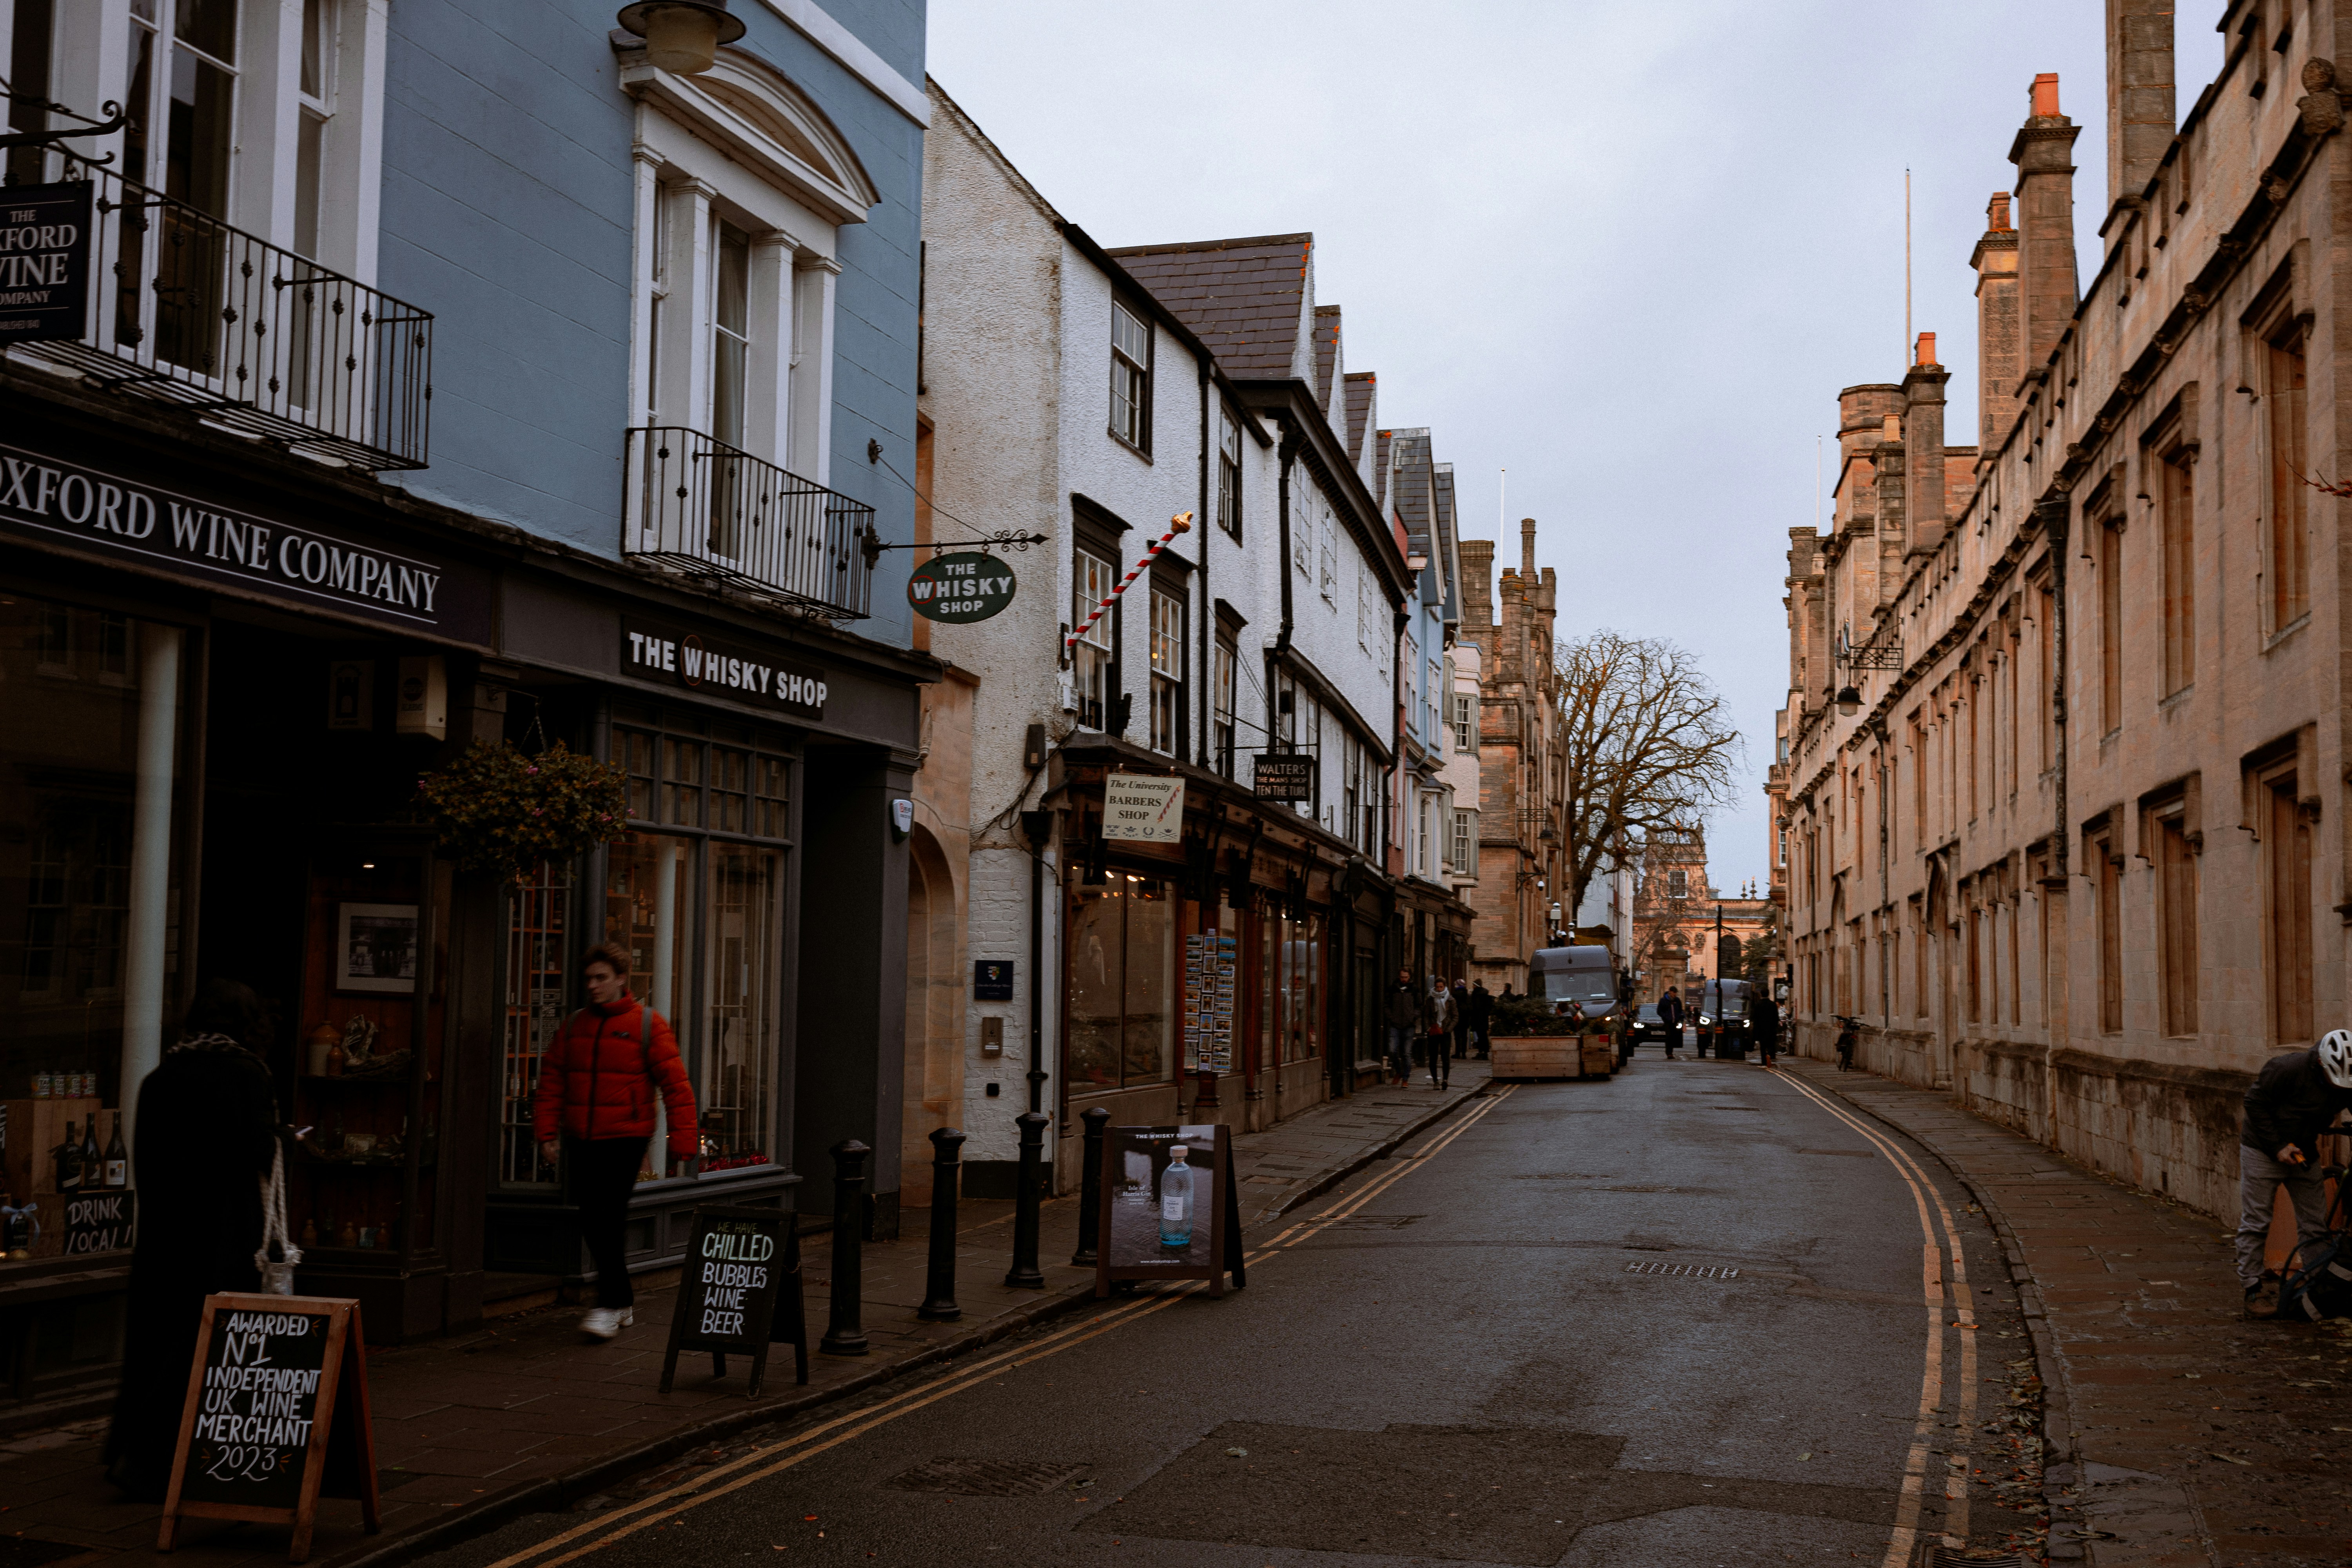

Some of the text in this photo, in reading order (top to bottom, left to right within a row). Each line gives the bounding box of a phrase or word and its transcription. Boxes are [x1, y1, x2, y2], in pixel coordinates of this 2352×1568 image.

[9, 210, 37, 223] THE
[0, 456, 440, 612] XFORD WINE COMPANY
[945, 563, 976, 575] THE
[913, 577, 1012, 599] WHISKY
[940, 601, 984, 613] SHOP
[629, 632, 828, 708] THE WHISKY SHOP
[1257, 764, 1306, 774] WALTERS
[1110, 780, 1172, 793] The University
[1256, 786, 1307, 796] TEN THE TURL
[1109, 795, 1161, 807] BARBERS
[1118, 810, 1149, 820] SHOP
[67, 1196, 122, 1226] DRINK
[717, 1221, 757, 1234] WE HAVE
[701, 1232, 774, 1261] CHILLED
[702, 1262, 767, 1289] BUBBLES
[703, 1286, 747, 1309] WINE
[225, 1312, 309, 1336] AWARDED
[700, 1309, 744, 1335] BEER
[206, 1366, 321, 1394] INDEPENDENT
[205, 1388, 303, 1419] UK WINE
[195, 1414, 313, 1446] MERCHANT
[206, 1445, 277, 1481] 2023
